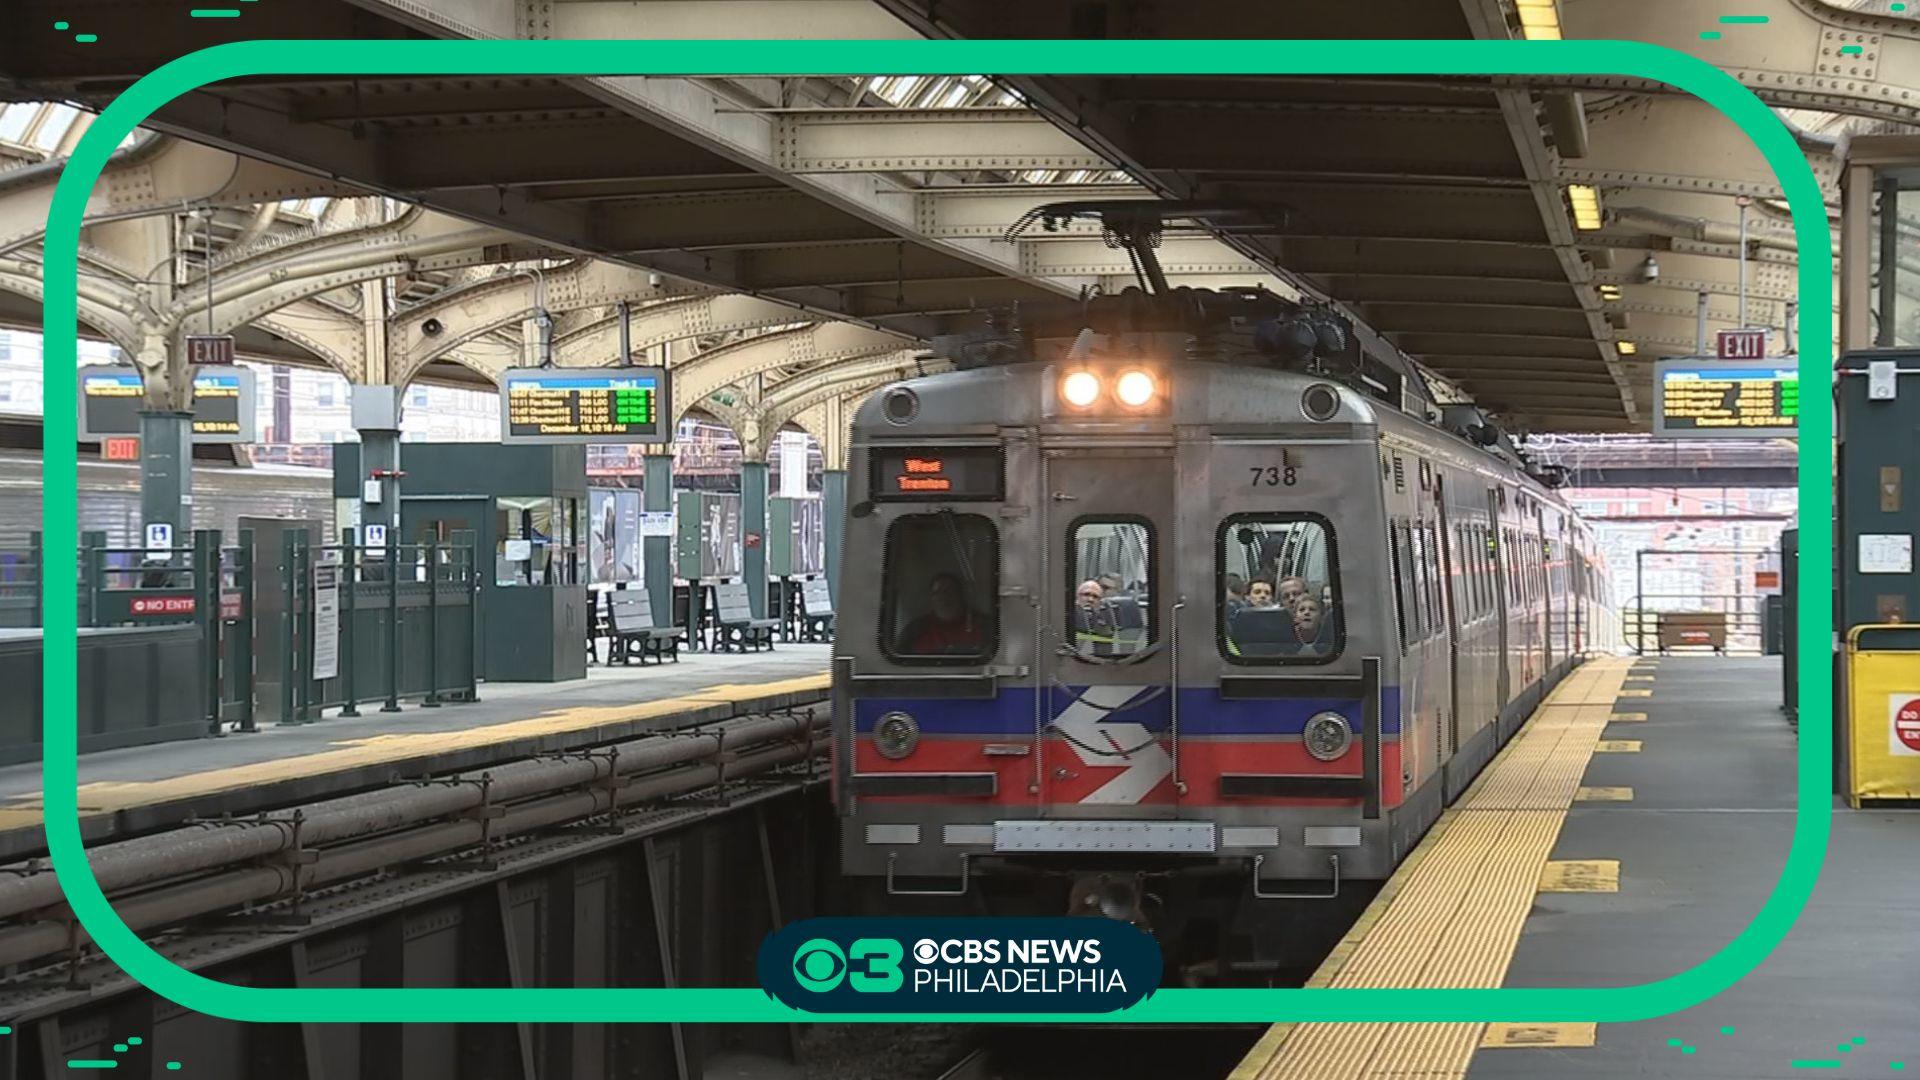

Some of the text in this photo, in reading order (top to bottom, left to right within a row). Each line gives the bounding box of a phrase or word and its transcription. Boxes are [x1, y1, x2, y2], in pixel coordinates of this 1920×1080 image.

[1724, 334, 1761, 357] EXIT
[194, 340, 228, 362] EXIT
[593, 407, 608, 415] LOC
[593, 416, 608, 424] LOC
[540, 424, 579, 433] December
[108, 439, 138, 460] EXIT
[1250, 466, 1297, 487] 738
[146, 600, 164, 610] NO
[1902, 710, 1918, 720] DO
